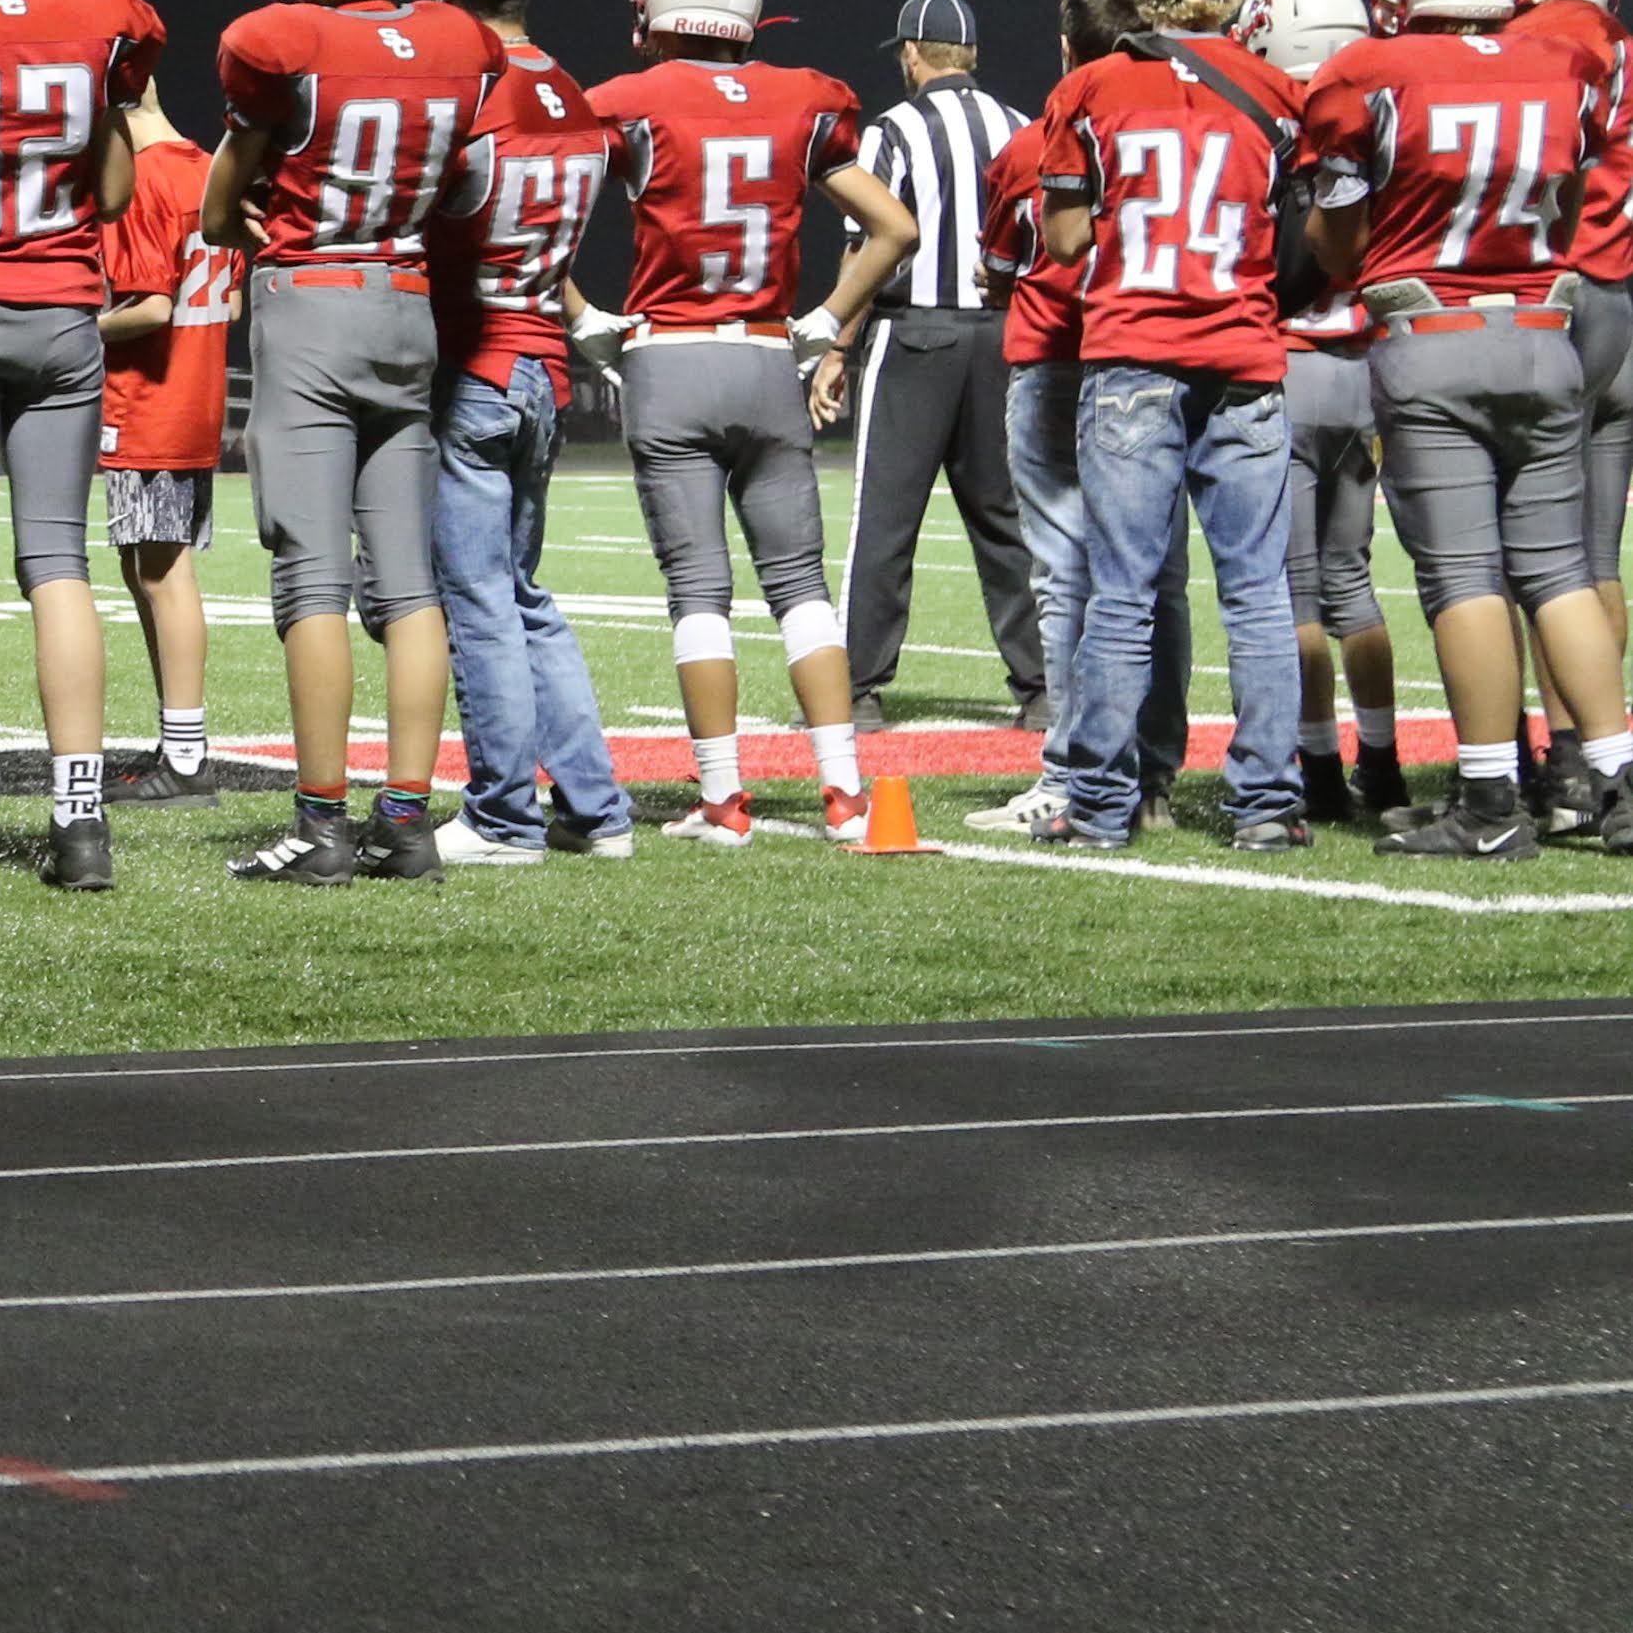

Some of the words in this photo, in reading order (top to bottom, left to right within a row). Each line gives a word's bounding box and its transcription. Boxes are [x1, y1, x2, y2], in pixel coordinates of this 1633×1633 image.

[377, 27, 415, 60] SC
[674, 16, 741, 39] Riddell
[534, 82, 567, 119] SC
[712, 75, 749, 103] SC
[313, 98, 458, 256] 81
[700, 135, 774, 295] 5
[1115, 128, 1247, 294] 24
[1428, 102, 1563, 268] 74
